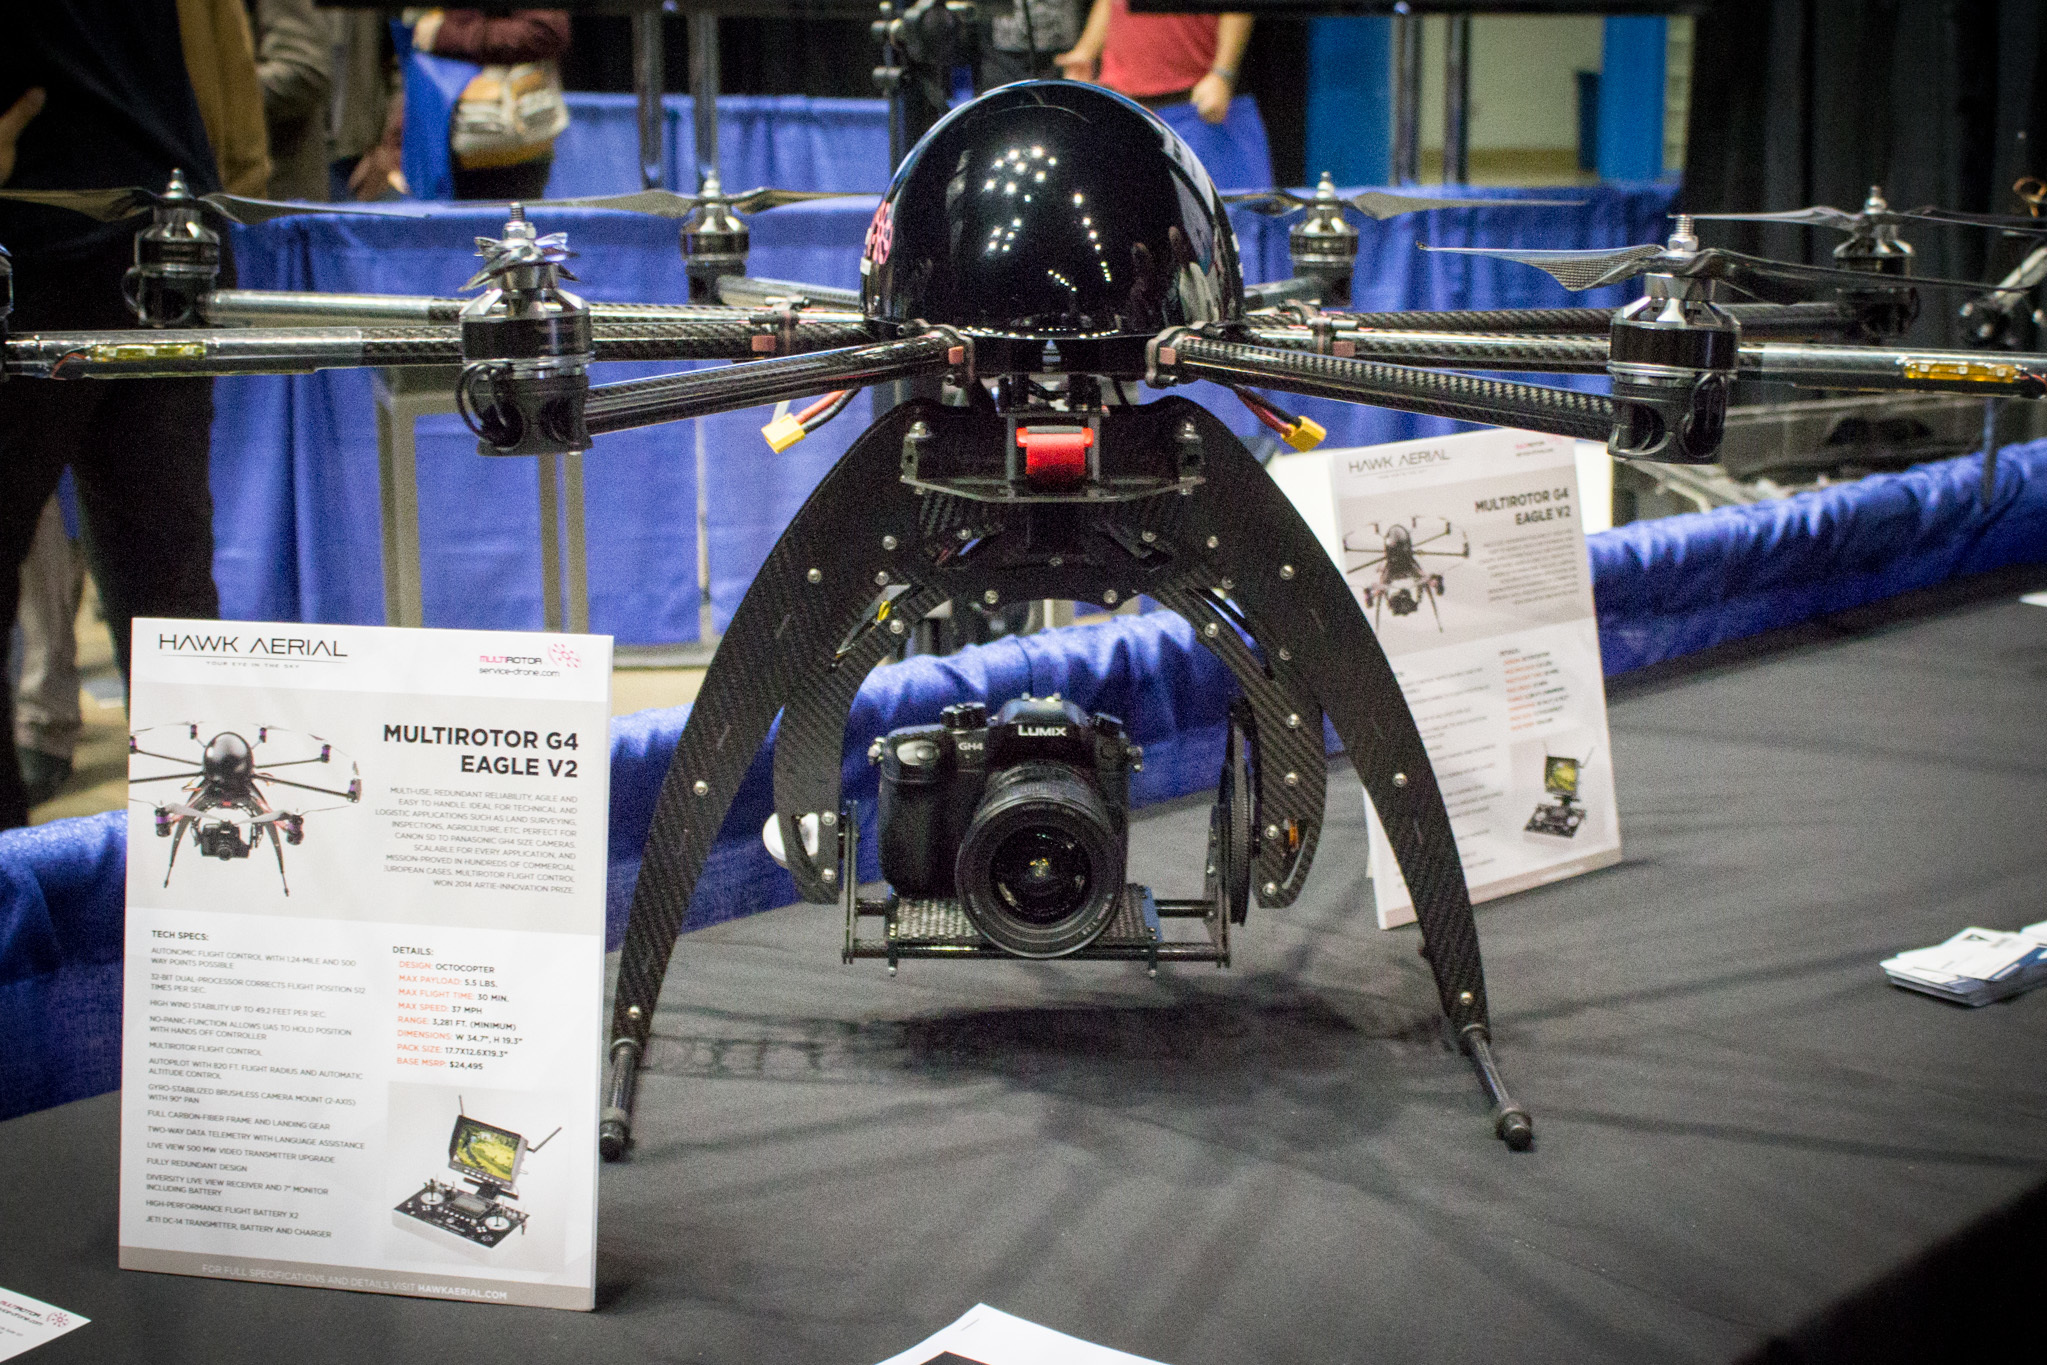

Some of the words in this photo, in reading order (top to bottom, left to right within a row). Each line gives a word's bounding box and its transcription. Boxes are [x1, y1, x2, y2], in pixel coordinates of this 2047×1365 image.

[1348, 456, 1393, 474] HAWK
[1399, 449, 1451, 467] AERIAL
[1475, 490, 1550, 513] MULTIROTOR
[1515, 508, 1553, 526] EAGLE
[1555, 505, 1571, 518] V2
[159, 633, 238, 652] HAWK
[249, 637, 348, 657] AERIAL
[479, 654, 542, 665] MULTIROTOR
[384, 724, 538, 749] MULTIROTOR
[546, 731, 578, 751] G4
[1018, 724, 1067, 737] LUMIX
[958, 742, 983, 751] GH4
[461, 754, 539, 776] EAGLE
[547, 758, 578, 778] V2
[434, 788, 483, 798] REDUNDANT
[534, 793, 557, 802] AGILE
[560, 794, 578, 803] AND
[398, 797, 419, 806] EASY
[421, 798, 432, 807] TO
[469, 801, 492, 810] IDEAL
[494, 802, 512, 811] FOR
[513, 803, 557, 814] TECHNICAL
[559, 806, 578, 815] AND
[375, 807, 410, 817] LOGISTIC
[412, 809, 469, 820] APPLICATIONS
[469, 812, 492, 821] SUCH
[493, 814, 504, 822] AS
[505, 814, 529, 823] LAND
[394, 831, 424, 840] CANON
[438, 833, 449, 842] TO
[450, 834, 496, 844] PANASONIC
[498, 837, 515, 846] GH4
[516, 837, 533, 847] SIZE
[522, 826, 558, 836] PERFECT
[559, 828, 577, 837] FOR
[413, 843, 454, 853] SCALABLE
[456, 845, 473, 854] FOR
[474, 846, 500, 856] EVERY
[558, 851, 577, 860] AND
[385, 853, 453, 865] MISSION-PROVED
[464, 857, 508, 868] HUNDREDS
[509, 860, 520, 868] OF
[522, 861, 575, 871] COMMERCIAL
[455, 868, 506, 879] MULTIROTOR
[506, 871, 535, 881] FLIGHT
[536, 873, 575, 883] CONTROL
[433, 878, 453, 887] WON
[455, 879, 472, 888] 2014
[474, 880, 549, 893] ARTIE-INNOVATION
[151, 929, 176, 939] TECH
[435, 962, 495, 974] OCTOCOPTER
[398, 973, 417, 983] MAX
[464, 977, 477, 987] 5.5
[398, 987, 417, 996] MAX
[419, 988, 450, 999] FLIGHT
[477, 992, 489, 1001] 30
[149, 998, 169, 1007] HIGH
[169, 1000, 191, 1009] WIND
[192, 1001, 230, 1011] STABILITY
[230, 1004, 242, 1012] UP
[243, 1004, 254, 1013] TO
[272, 1007, 291, 1016] FEET
[293, 1008, 309, 1017] PER
[397, 1001, 416, 1010] MAX
[451, 1005, 462, 1013] 37
[463, 1005, 483, 1014] MPH
[433, 1017, 453, 1027] 3,281
[469, 1020, 517, 1031] (MINIMUM)
[455, 1032, 465, 1041] W
[493, 1035, 500, 1044] H
[148, 1040, 197, 1051] MULTIROTOR
[197, 1044, 224, 1054] FLIGHT
[225, 1046, 262, 1056] CONTROL
[397, 1042, 419, 1052] PACK
[396, 1056, 418, 1066] BASE
[449, 1060, 483, 1070] $24,495
[147, 1108, 166, 1118] FULL
[167, 1110, 225, 1122] CARBON-FIBER
[225, 1115, 251, 1124] FRAME
[254, 1117, 271, 1126] AND
[272, 1118, 308, 1129] LANDING
[308, 1121, 331, 1131] GEAR
[146, 1141, 163, 1150] LIVE
[165, 1142, 185, 1151] VIEW
[186, 1143, 202, 1153] 500
[202, 1145, 217, 1154] MW
[218, 1146, 243, 1156] VIDEO
[244, 1148, 297, 1160] TRANSMITTER
[297, 1153, 334, 1164] UPGRADE
[146, 1156, 170, 1166] FULLY
[170, 1158, 218, 1170] REDUNDANT
[219, 1162, 248, 1172] DESIGN
[145, 1198, 223, 1212] HIGH-PERFORMANCE
[224, 1205, 251, 1215] FLIGHT
[253, 1207, 287, 1218] BATTERY
[289, 1211, 299, 1219] X2
[162, 1216, 183, 1225] DC-14
[239, 1222, 274, 1233] BATTERY
[275, 1226, 293, 1235] AND
[294, 1227, 332, 1238] CHARGER
[201, 1263, 223, 1274] FOR
[223, 1265, 247, 1276] FULL
[248, 1267, 325, 1283] SPECIFICATIONS
[327, 1275, 349, 1286] AND
[350, 1277, 391, 1290] DETAILS
[391, 1281, 415, 1292] VISIT
[417, 1283, 508, 1301] HAWKAERIAL.COM
